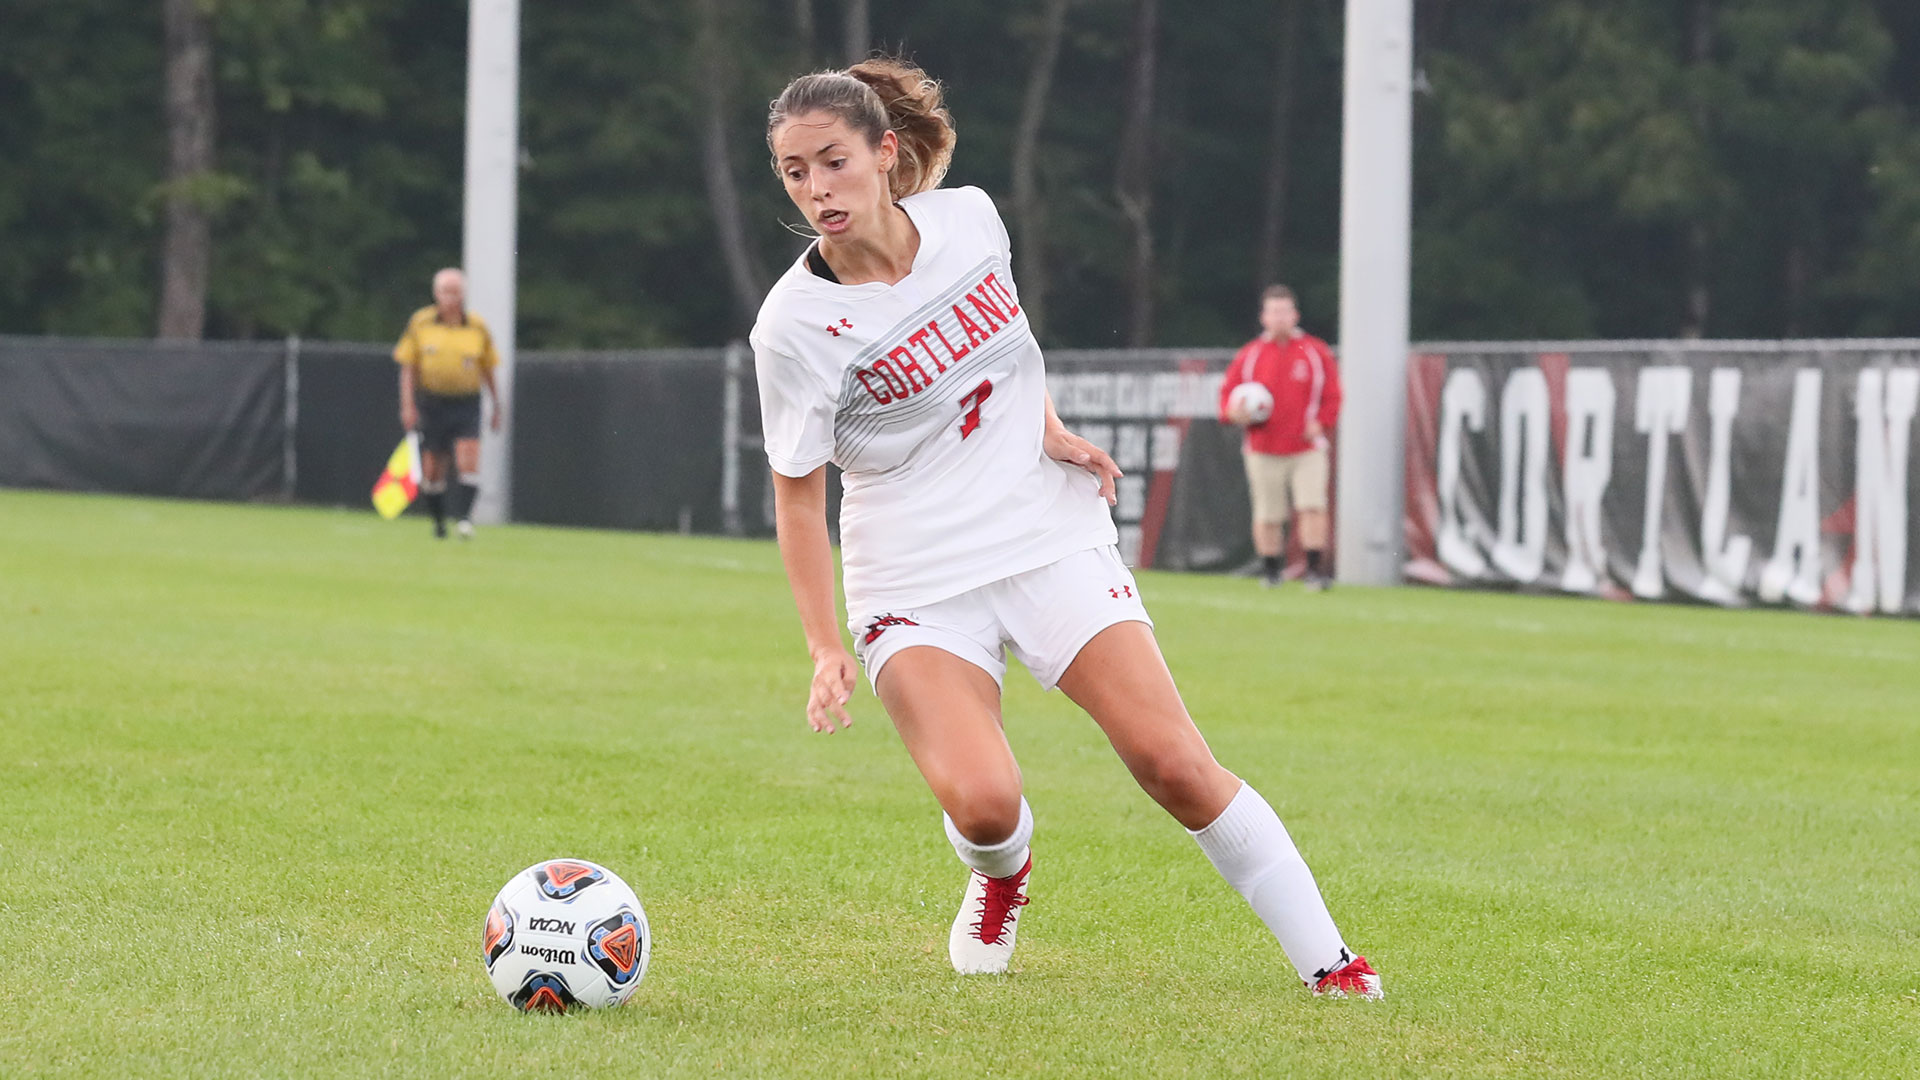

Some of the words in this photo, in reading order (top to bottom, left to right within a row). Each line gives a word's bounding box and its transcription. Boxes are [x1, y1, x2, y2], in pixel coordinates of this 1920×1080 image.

[856, 272, 1019, 405] CORTLAND
[958, 379, 993, 440] 7
[529, 917, 576, 935] NCAA
[520, 944, 576, 965] Wilson
